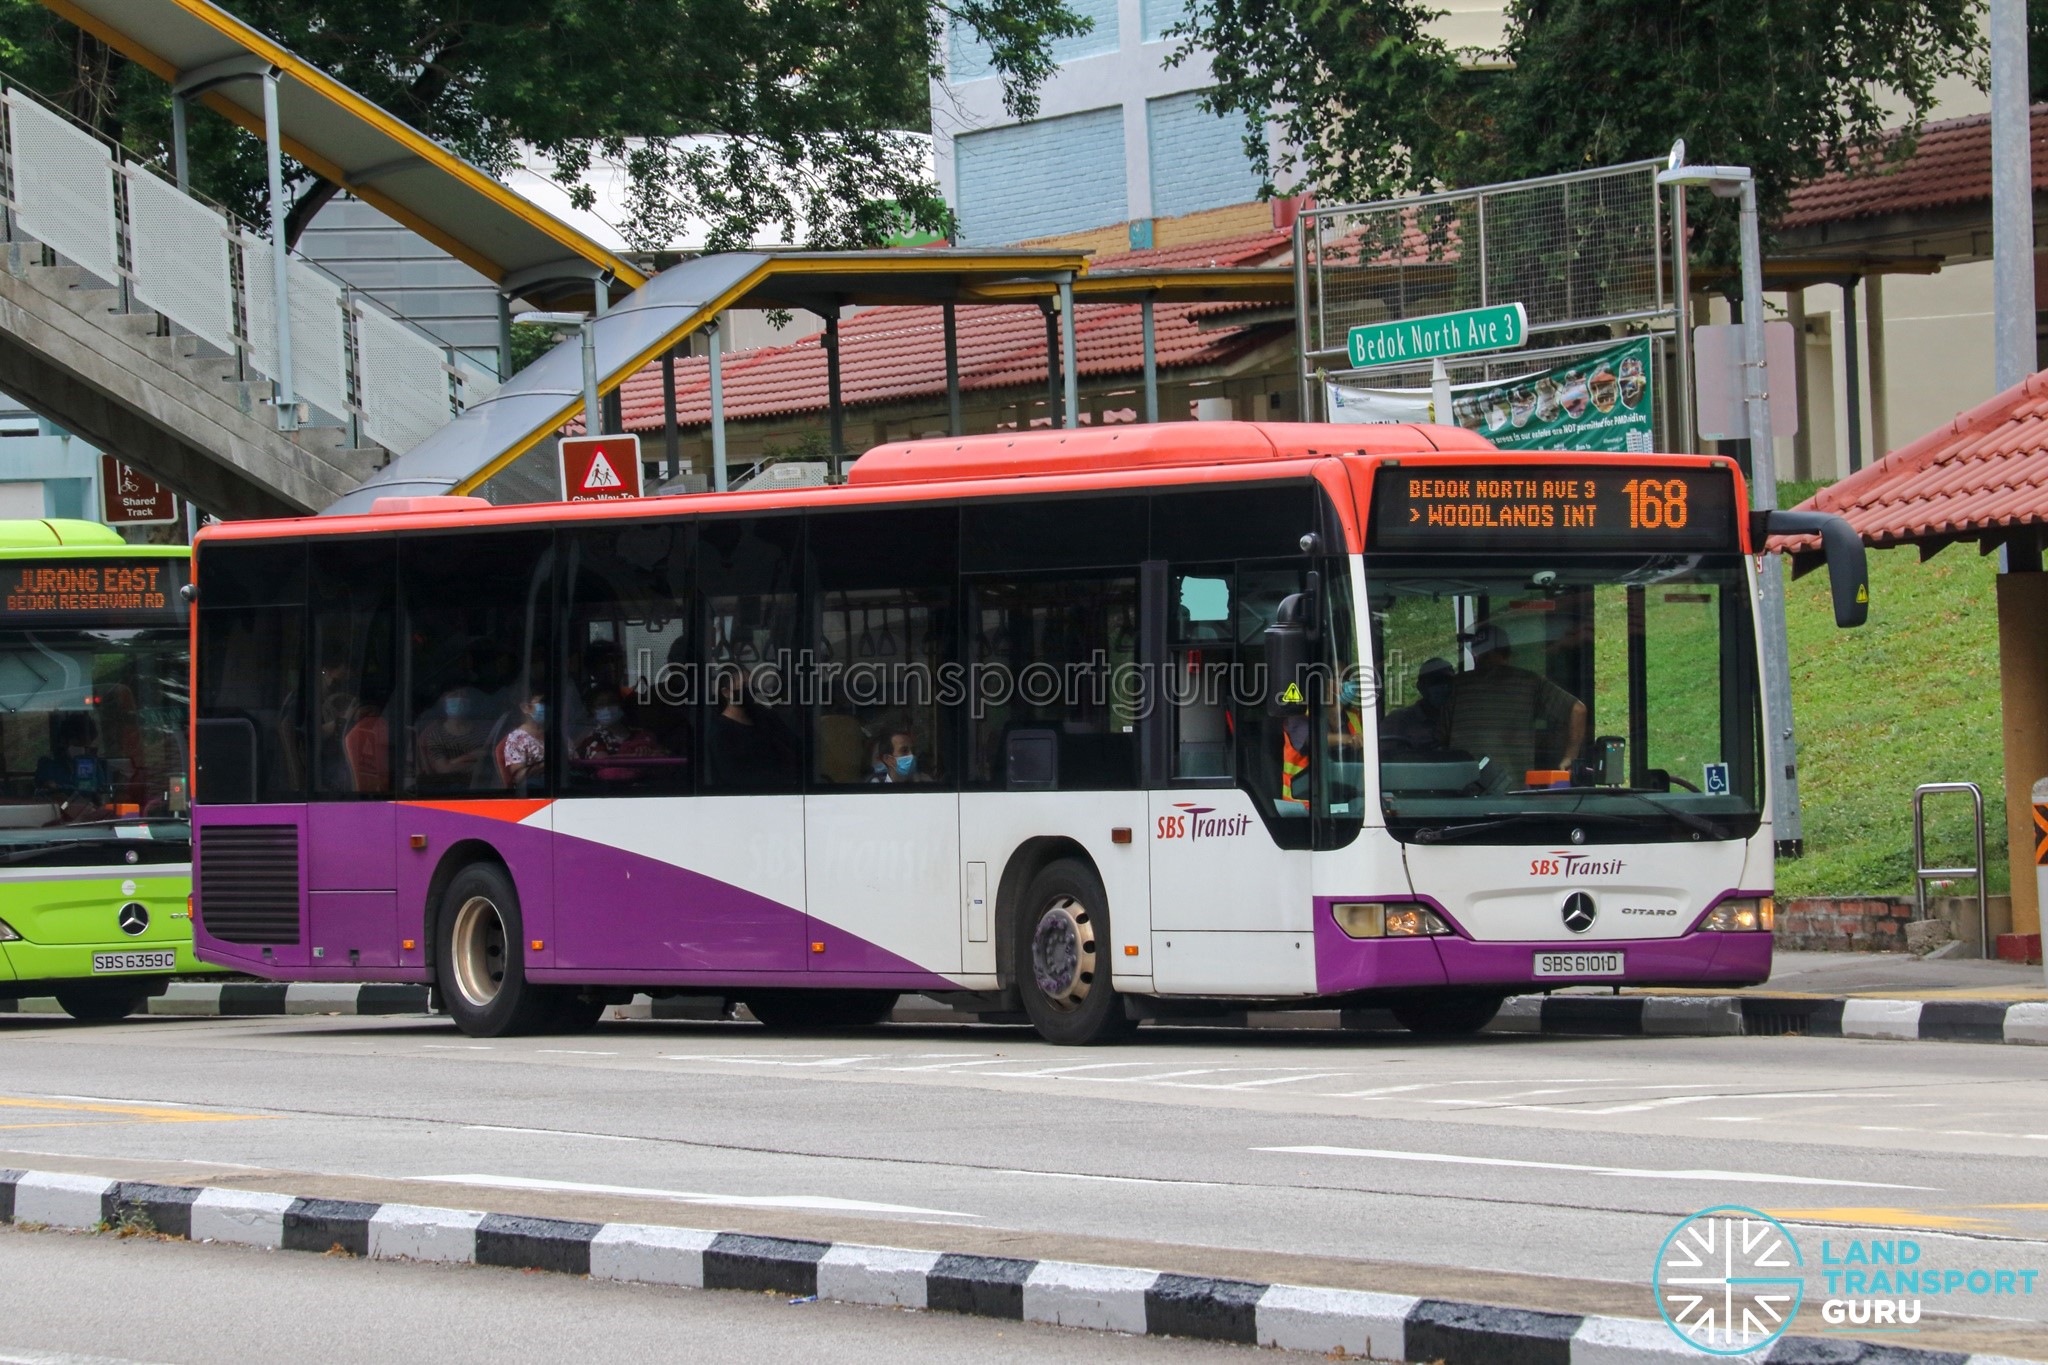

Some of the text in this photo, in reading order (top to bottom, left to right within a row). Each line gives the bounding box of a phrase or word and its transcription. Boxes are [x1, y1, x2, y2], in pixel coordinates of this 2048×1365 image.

[1355, 313, 1514, 362] Bedok North Ave 3
[1562, 423, 1576, 433] NOT
[1408, 479, 1596, 499] BEDOK NORTH AVE 3
[122, 497, 156, 507] Shared
[126, 507, 153, 517] Track
[1621, 478, 1688, 529] 168
[1427, 503, 1597, 527] WOODLANDS INT
[14, 567, 160, 593] JURONG EAST
[7, 593, 165, 610] BEDOK RESERVOIR RD
[1156, 807, 1254, 842] SBS Transit
[1530, 854, 1627, 878] SBS Transit
[1621, 908, 1678, 916] CITARO
